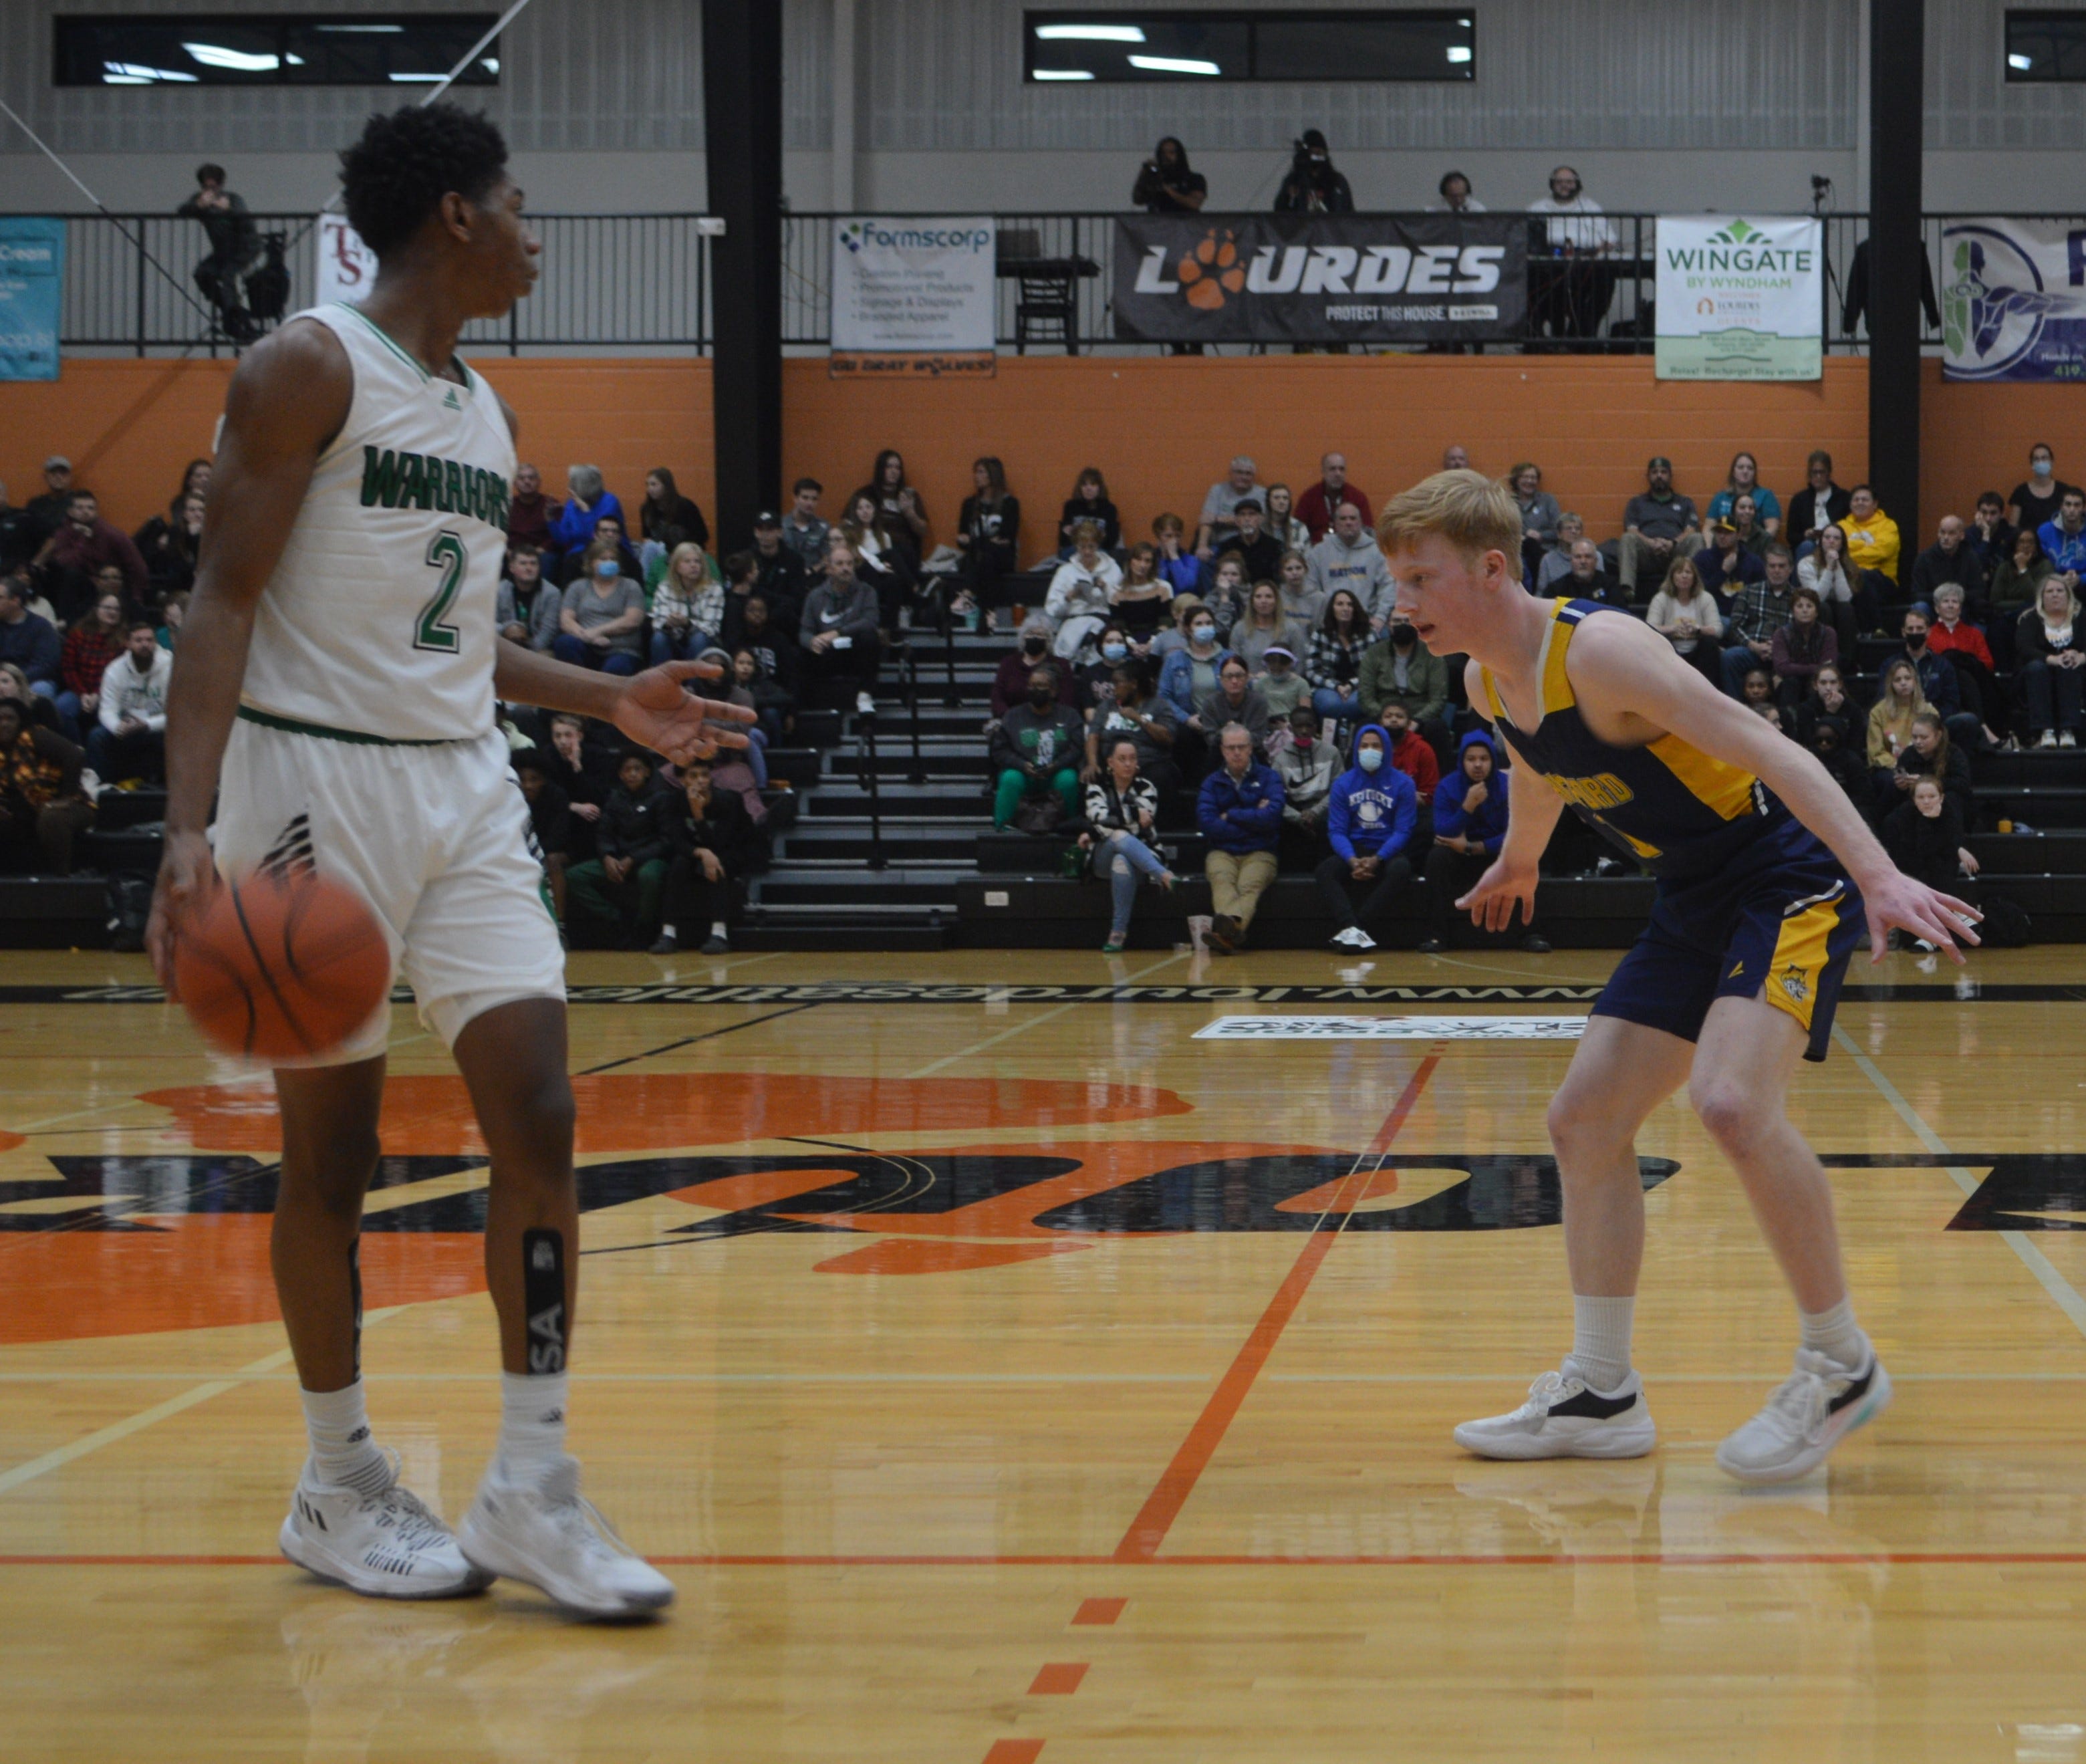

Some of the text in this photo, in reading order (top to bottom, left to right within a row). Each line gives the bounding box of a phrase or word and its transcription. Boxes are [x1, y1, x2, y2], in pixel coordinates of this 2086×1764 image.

[862, 223, 989, 253] formscorp
[1667, 249, 1812, 272] WINGATE
[1686, 277, 1791, 289] BY WYNDHAM
[1326, 305, 1378, 321] PROTECT
[413, 529, 469, 653] 2
